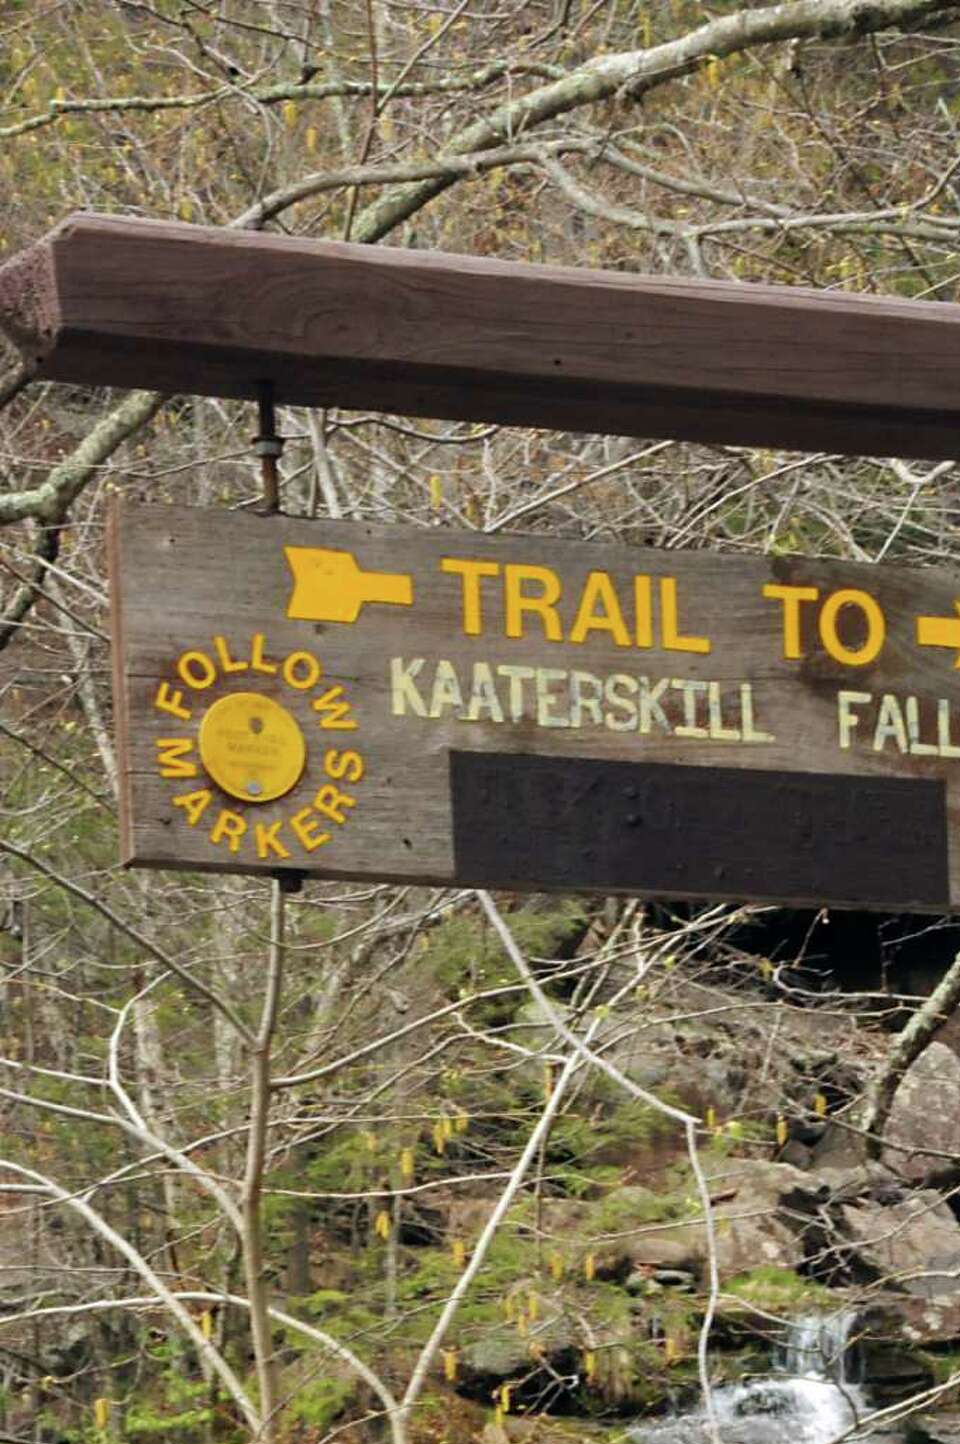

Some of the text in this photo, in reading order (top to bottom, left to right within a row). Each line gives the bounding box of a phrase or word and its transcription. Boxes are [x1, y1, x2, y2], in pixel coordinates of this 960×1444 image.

[440, 557, 886, 666] TRAIL TO
[157, 633, 358, 732] FOLLOW
[390, 656, 776, 742] KAATERSKILL
[156, 737, 364, 860] MARKERS
